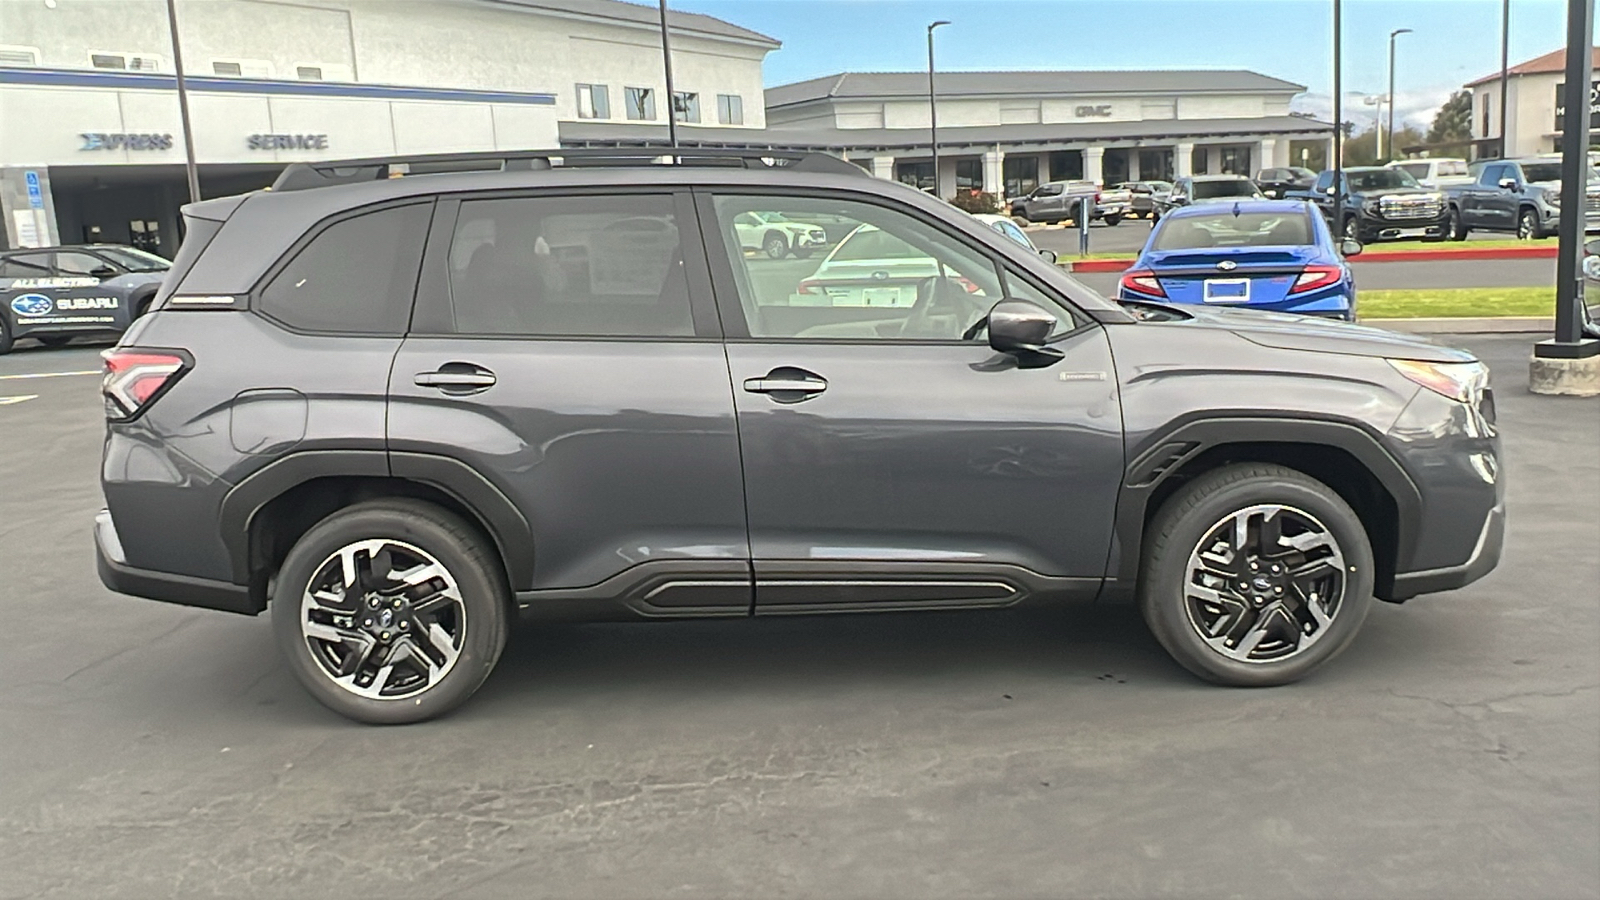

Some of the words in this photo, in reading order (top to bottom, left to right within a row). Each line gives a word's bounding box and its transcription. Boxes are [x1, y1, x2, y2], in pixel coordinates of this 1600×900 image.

[1075, 105, 1112, 117] GMC
[79, 133, 173, 150] EXPRESS
[246, 134, 329, 150] SERVICE
[12, 278, 38, 288] ALL
[39, 277, 100, 288] ELECTRIC
[57, 298, 118, 309] SUBARU
